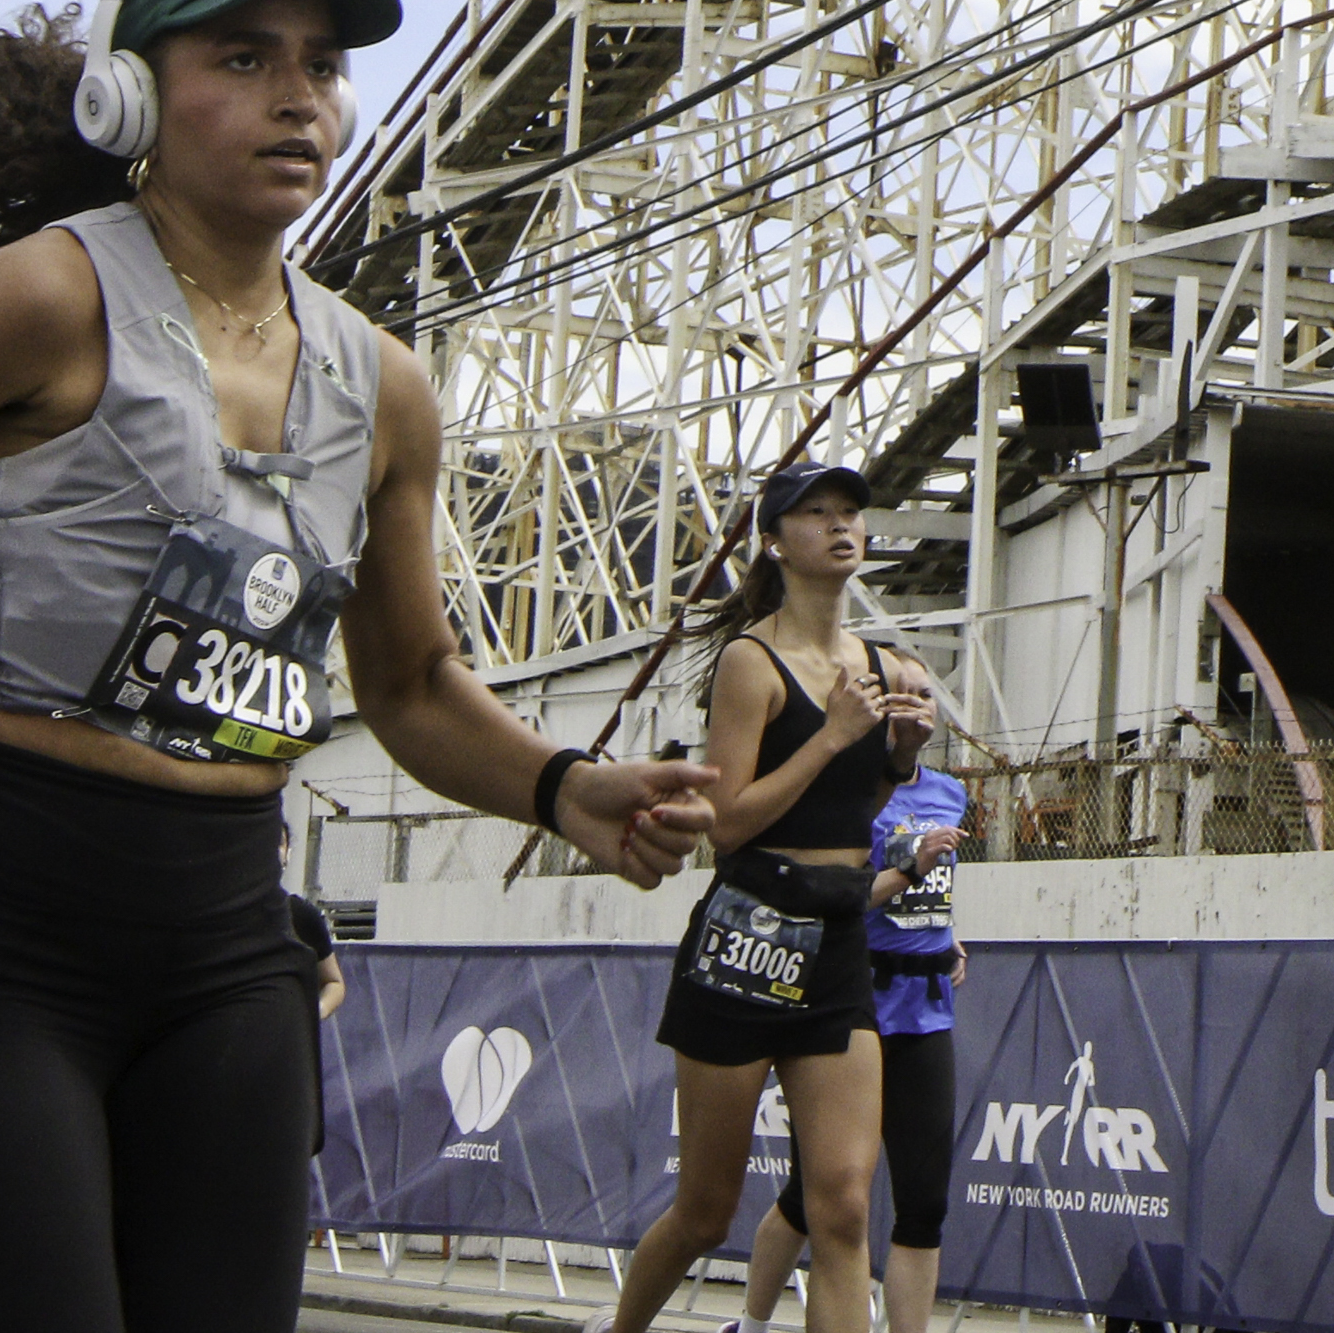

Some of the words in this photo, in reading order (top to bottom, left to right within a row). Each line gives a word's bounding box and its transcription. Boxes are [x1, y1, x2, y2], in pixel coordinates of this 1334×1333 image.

[249, 575, 296, 606] BROOKLYN
[255, 595, 279, 614] HALF
[176, 629, 313, 738] 38218
[234, 726, 258, 750] TFK
[720, 931, 804, 985] 31006
[967, 1183, 1004, 1205] NEW
[1008, 1185, 1042, 1208] YORK
[1044, 1189, 1085, 1212] ROAD
[1090, 1192, 1170, 1218] RUNNERS
